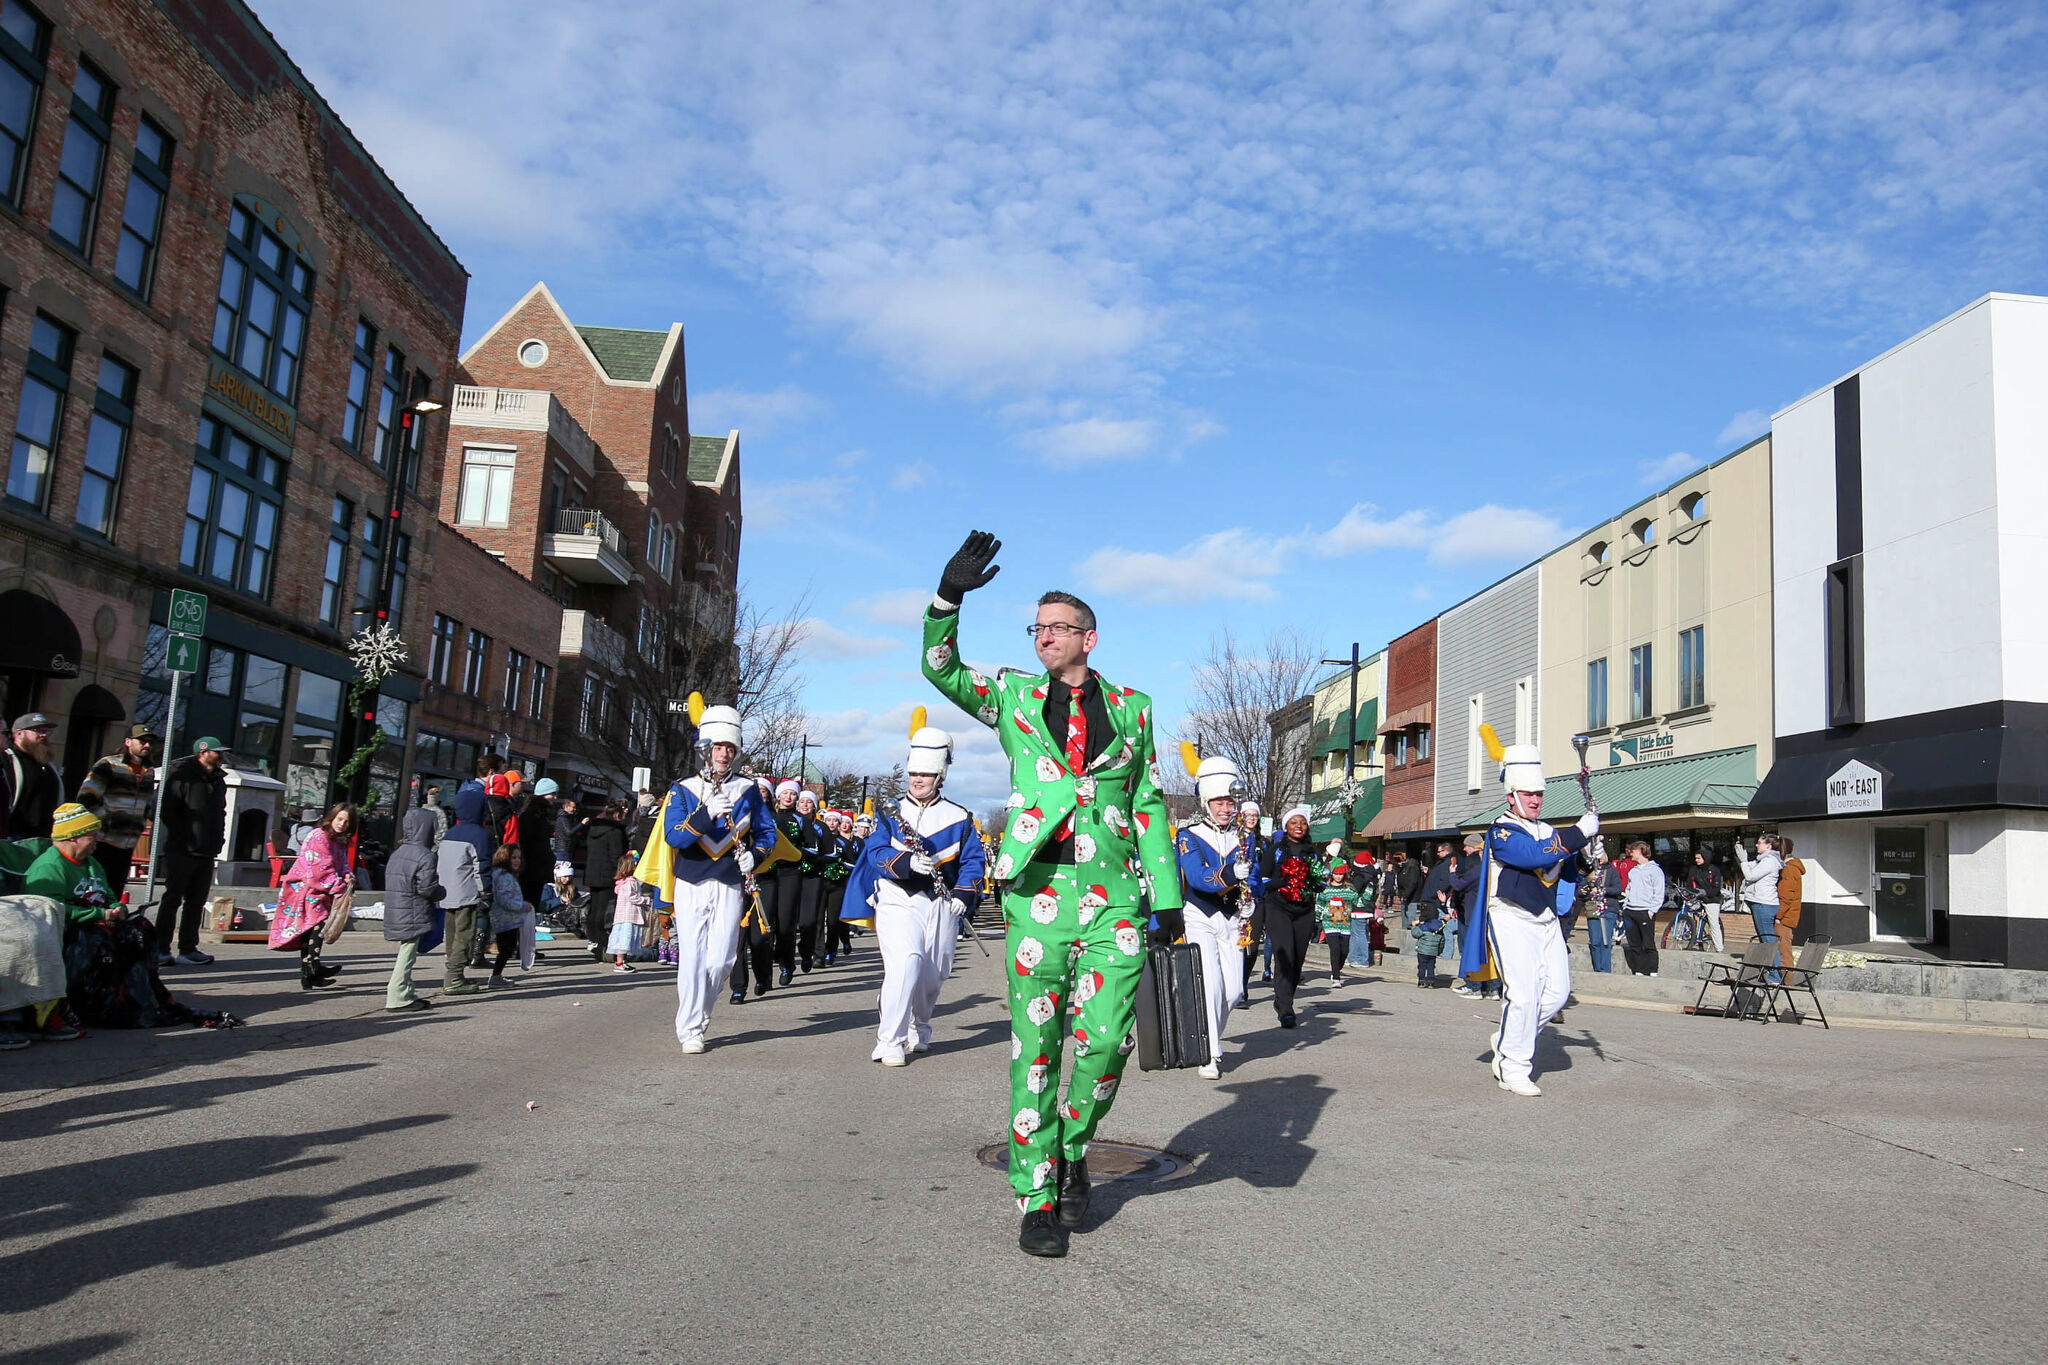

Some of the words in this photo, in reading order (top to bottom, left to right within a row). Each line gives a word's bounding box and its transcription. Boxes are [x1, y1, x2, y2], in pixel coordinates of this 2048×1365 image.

[208, 363, 254, 413] LARKIN
[254, 394, 294, 440] BLOCK
[171, 620, 184, 630] BIKE
[184, 622, 200, 634] ROUTE
[1640, 735, 1655, 750] little
[1656, 731, 1673, 747] forks
[1639, 749, 1674, 762] OUTFITTERS
[1856, 777, 1877, 795] EAST
[1838, 799, 1870, 808] OUTDOORS
